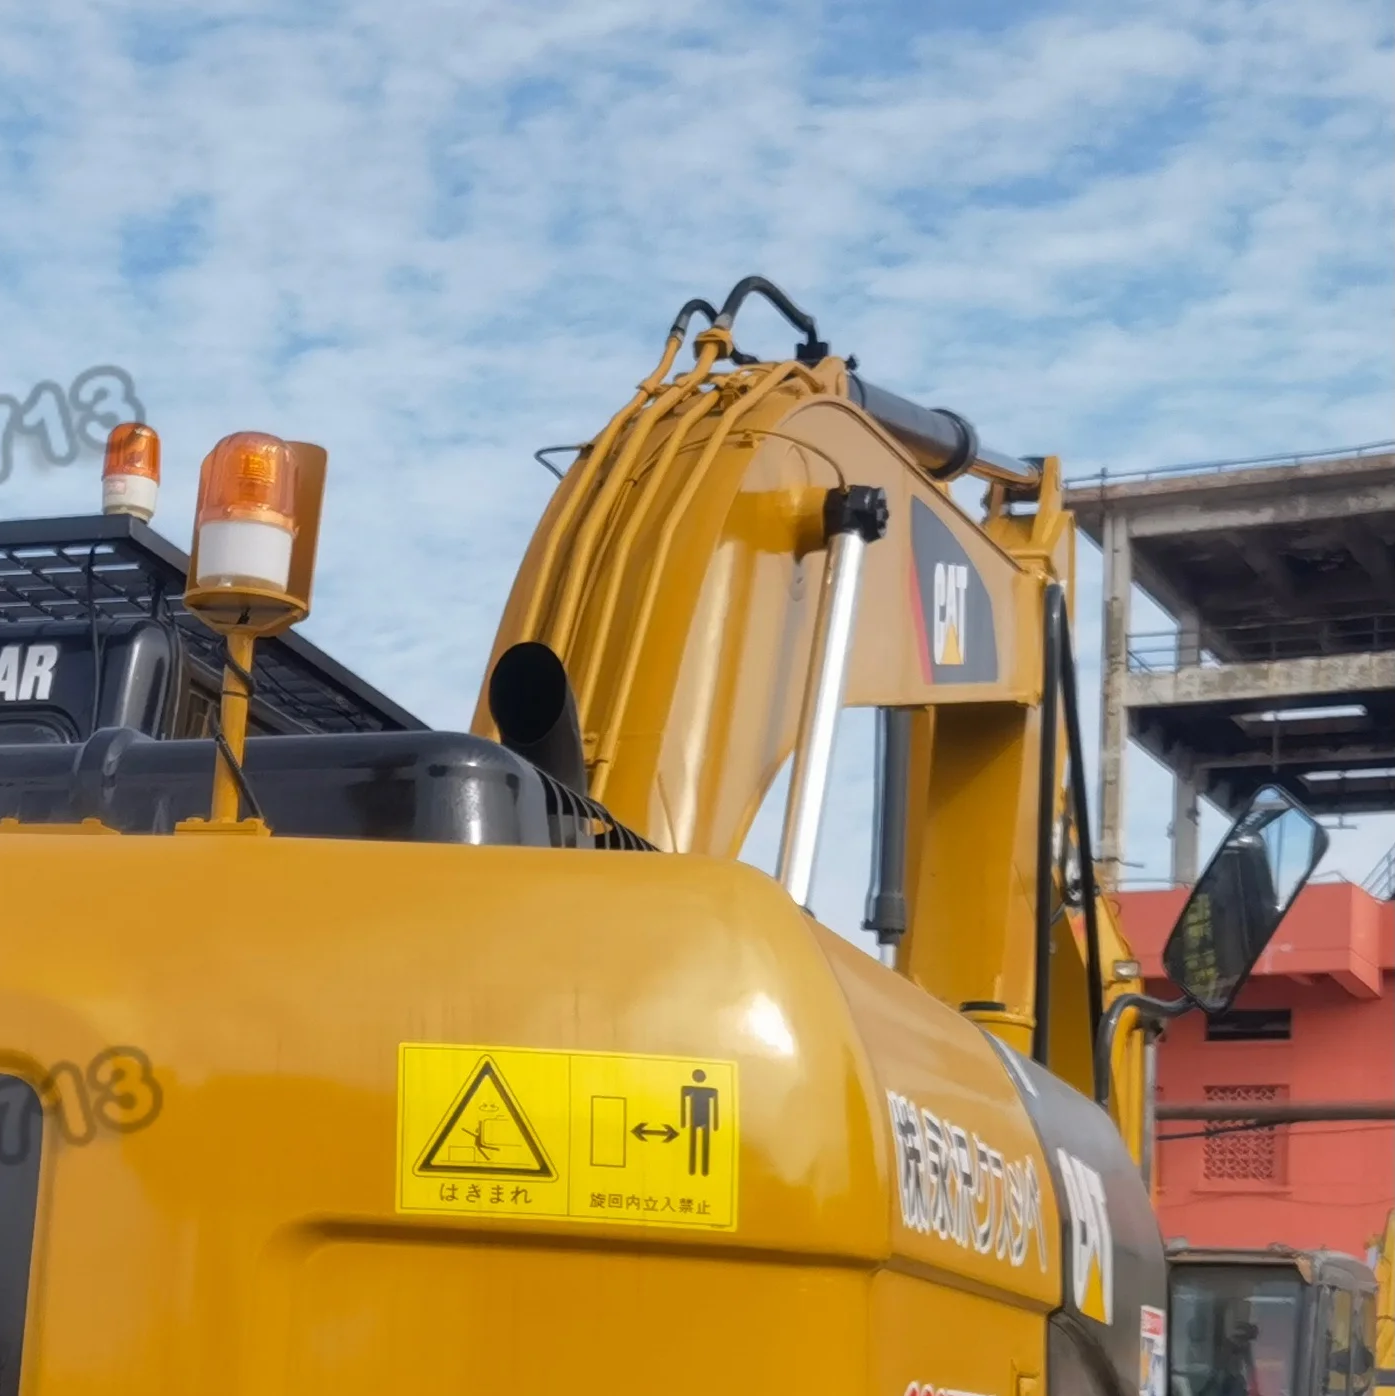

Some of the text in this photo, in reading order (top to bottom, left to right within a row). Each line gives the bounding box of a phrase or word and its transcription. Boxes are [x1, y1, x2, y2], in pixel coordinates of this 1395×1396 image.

[933, 562, 968, 665] CAT
[589, 1192, 711, 1216] 旋回内立入禁止
[1057, 1148, 1112, 1325] CAT
